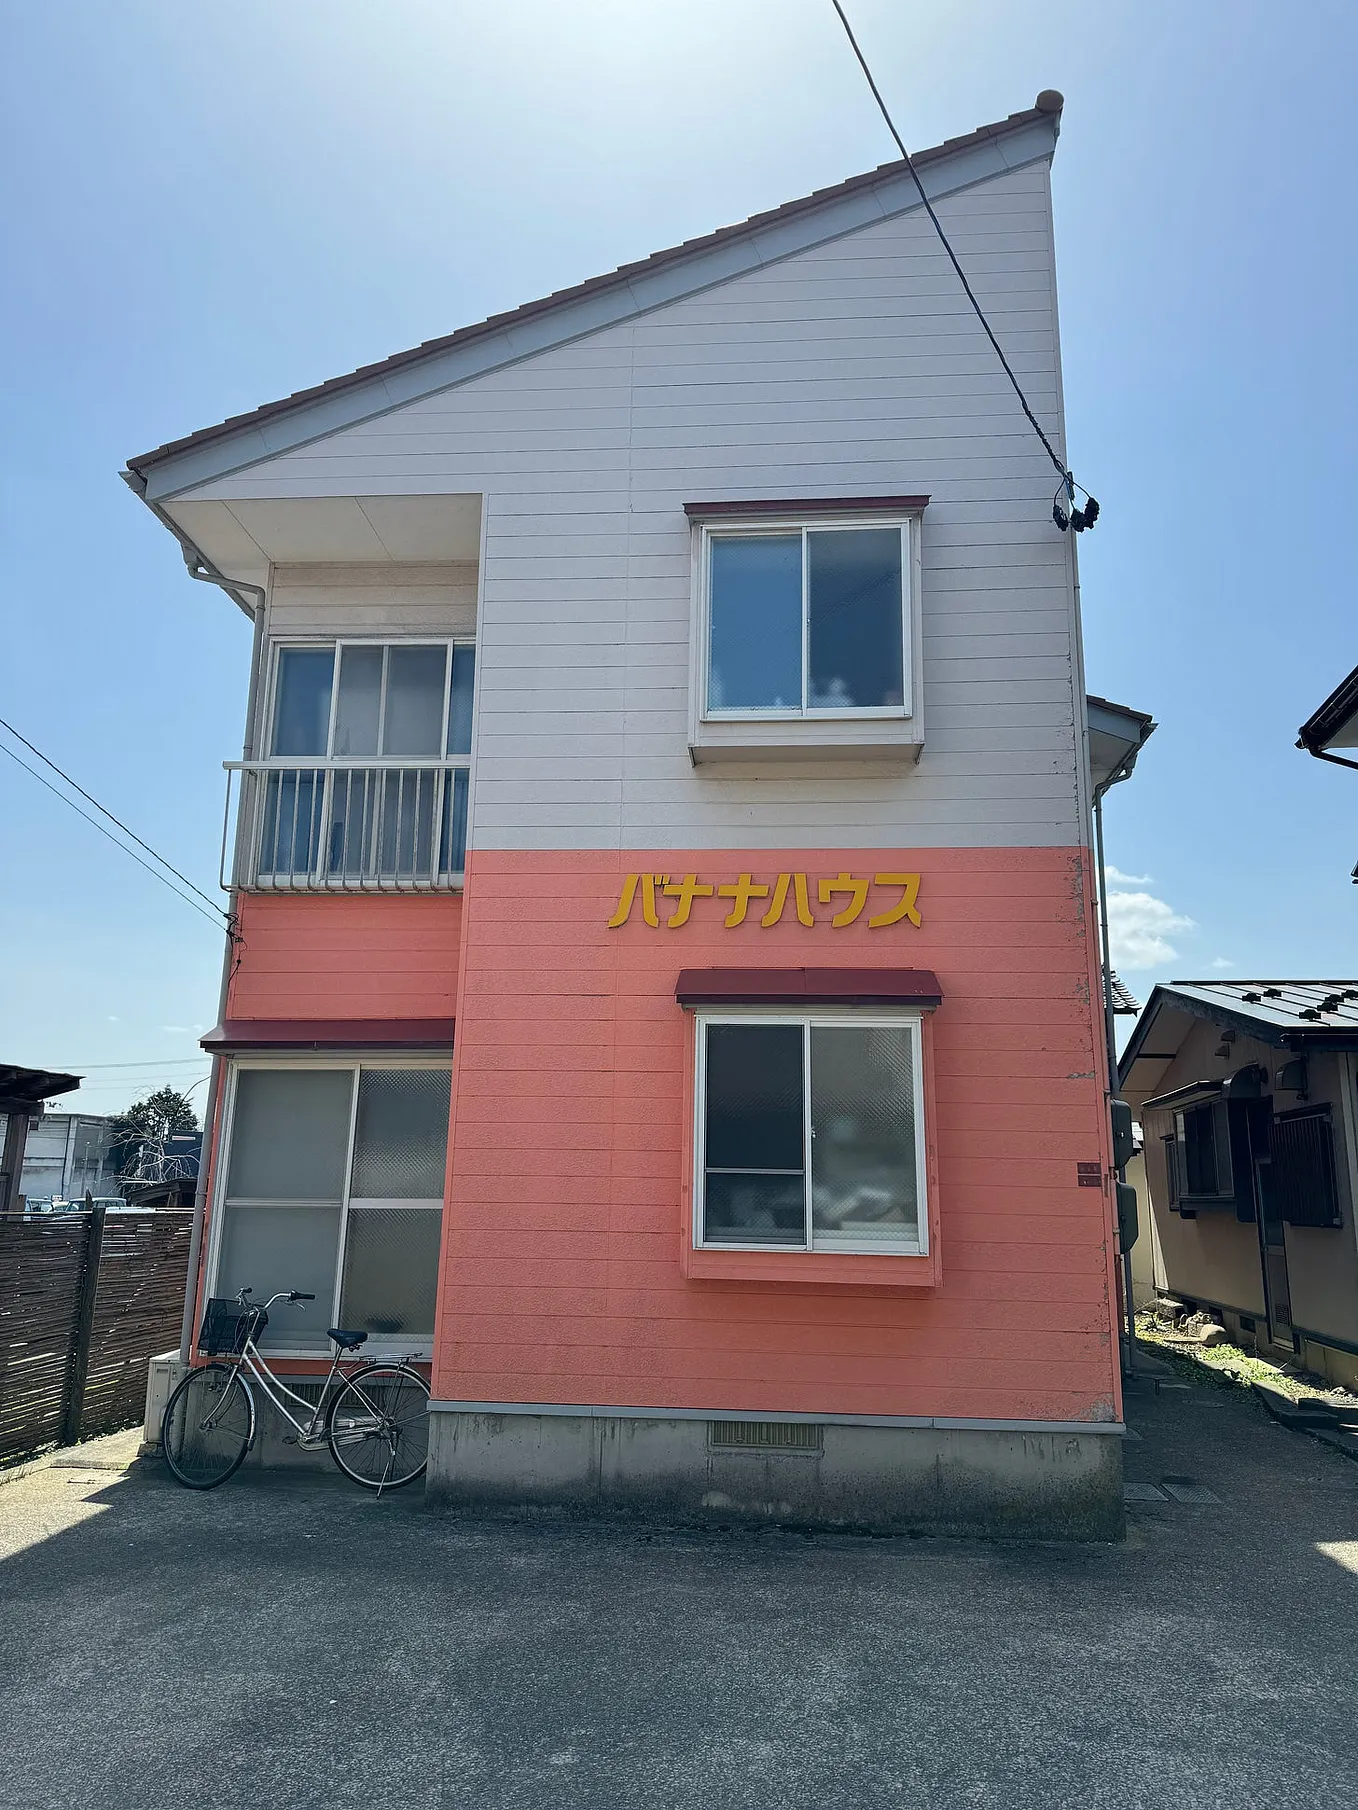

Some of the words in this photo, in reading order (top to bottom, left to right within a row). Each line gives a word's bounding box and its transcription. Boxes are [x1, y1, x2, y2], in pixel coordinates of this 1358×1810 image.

[608, 872, 921, 928] バナナハウス
